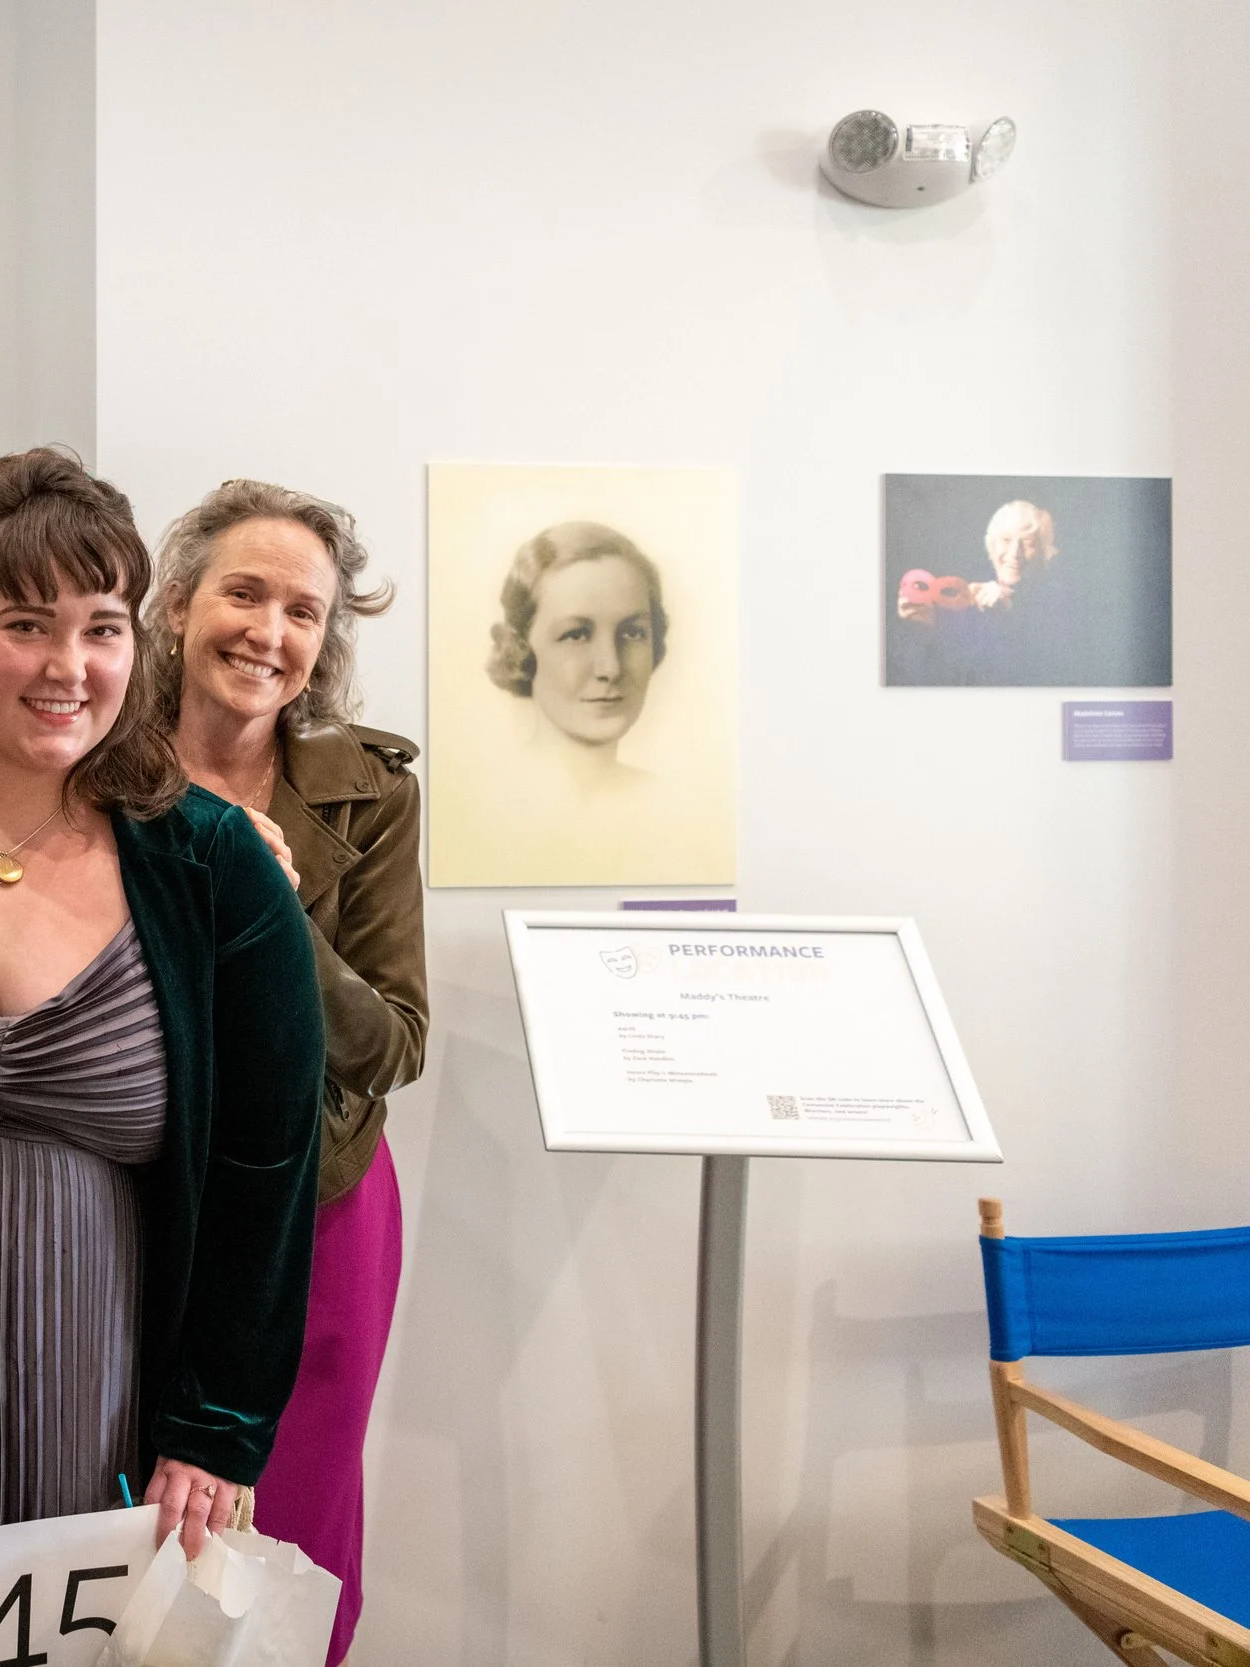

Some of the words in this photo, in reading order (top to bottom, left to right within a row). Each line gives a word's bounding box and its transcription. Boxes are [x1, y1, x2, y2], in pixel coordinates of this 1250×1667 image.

[668, 943, 825, 960] PERFORMANCE
[679, 992, 726, 1003] Maddy's
[612, 1010, 655, 1021] Showing
